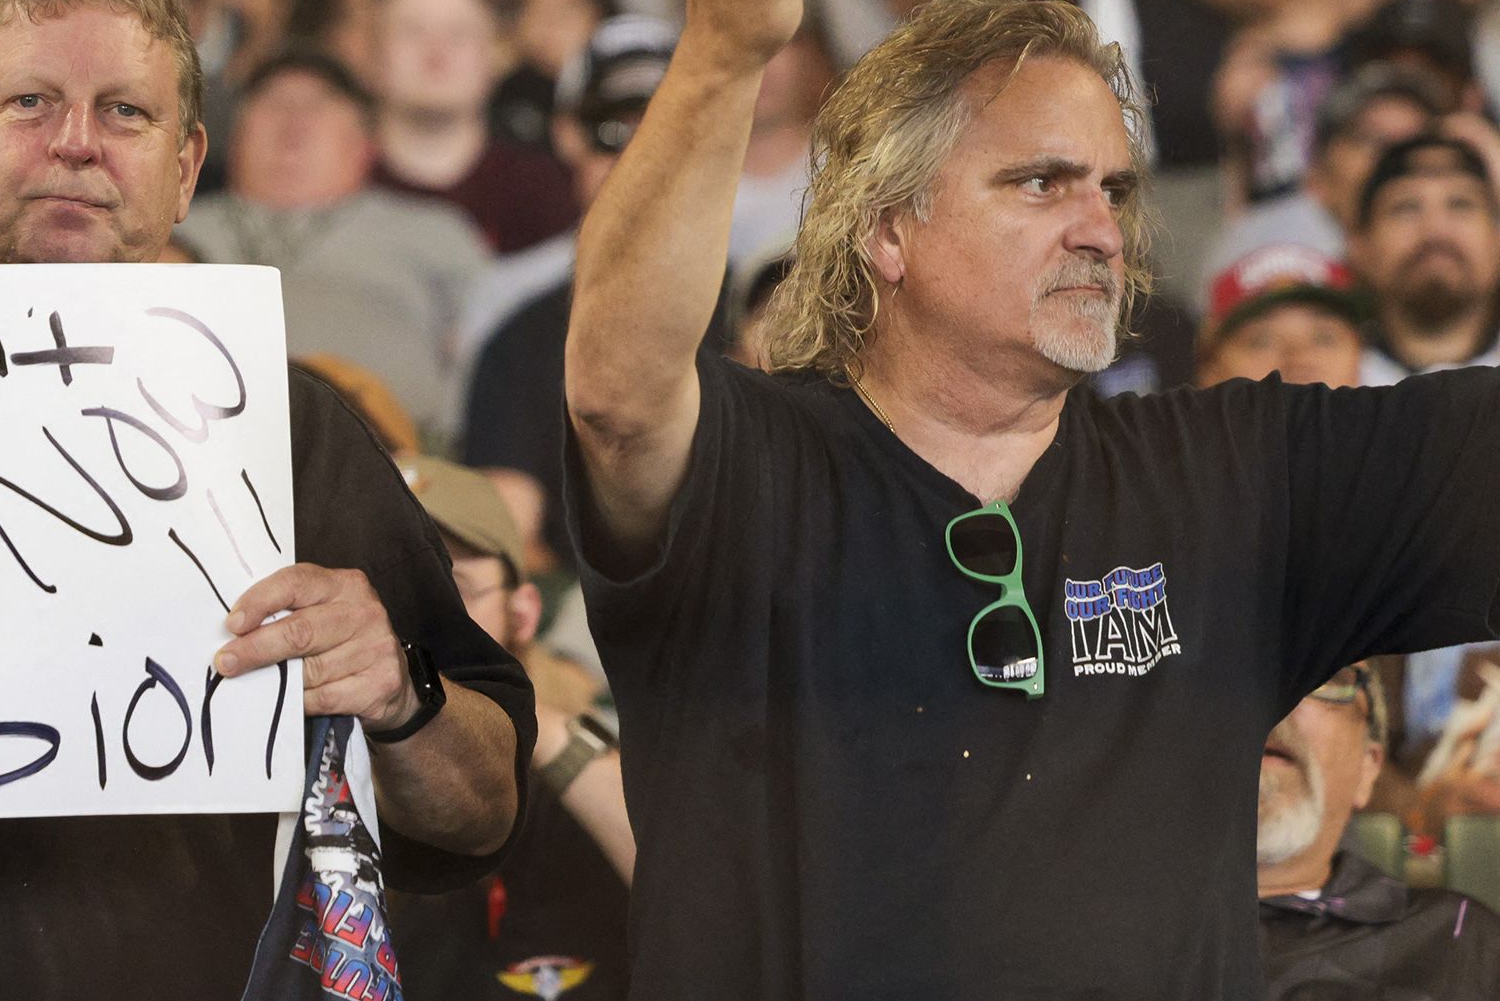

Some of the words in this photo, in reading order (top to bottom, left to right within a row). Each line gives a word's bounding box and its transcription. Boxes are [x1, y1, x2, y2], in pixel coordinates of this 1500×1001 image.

[1066, 581, 1102, 598] OUR
[1065, 596, 1111, 619] OUR
[1074, 662, 1126, 677] PROUD
